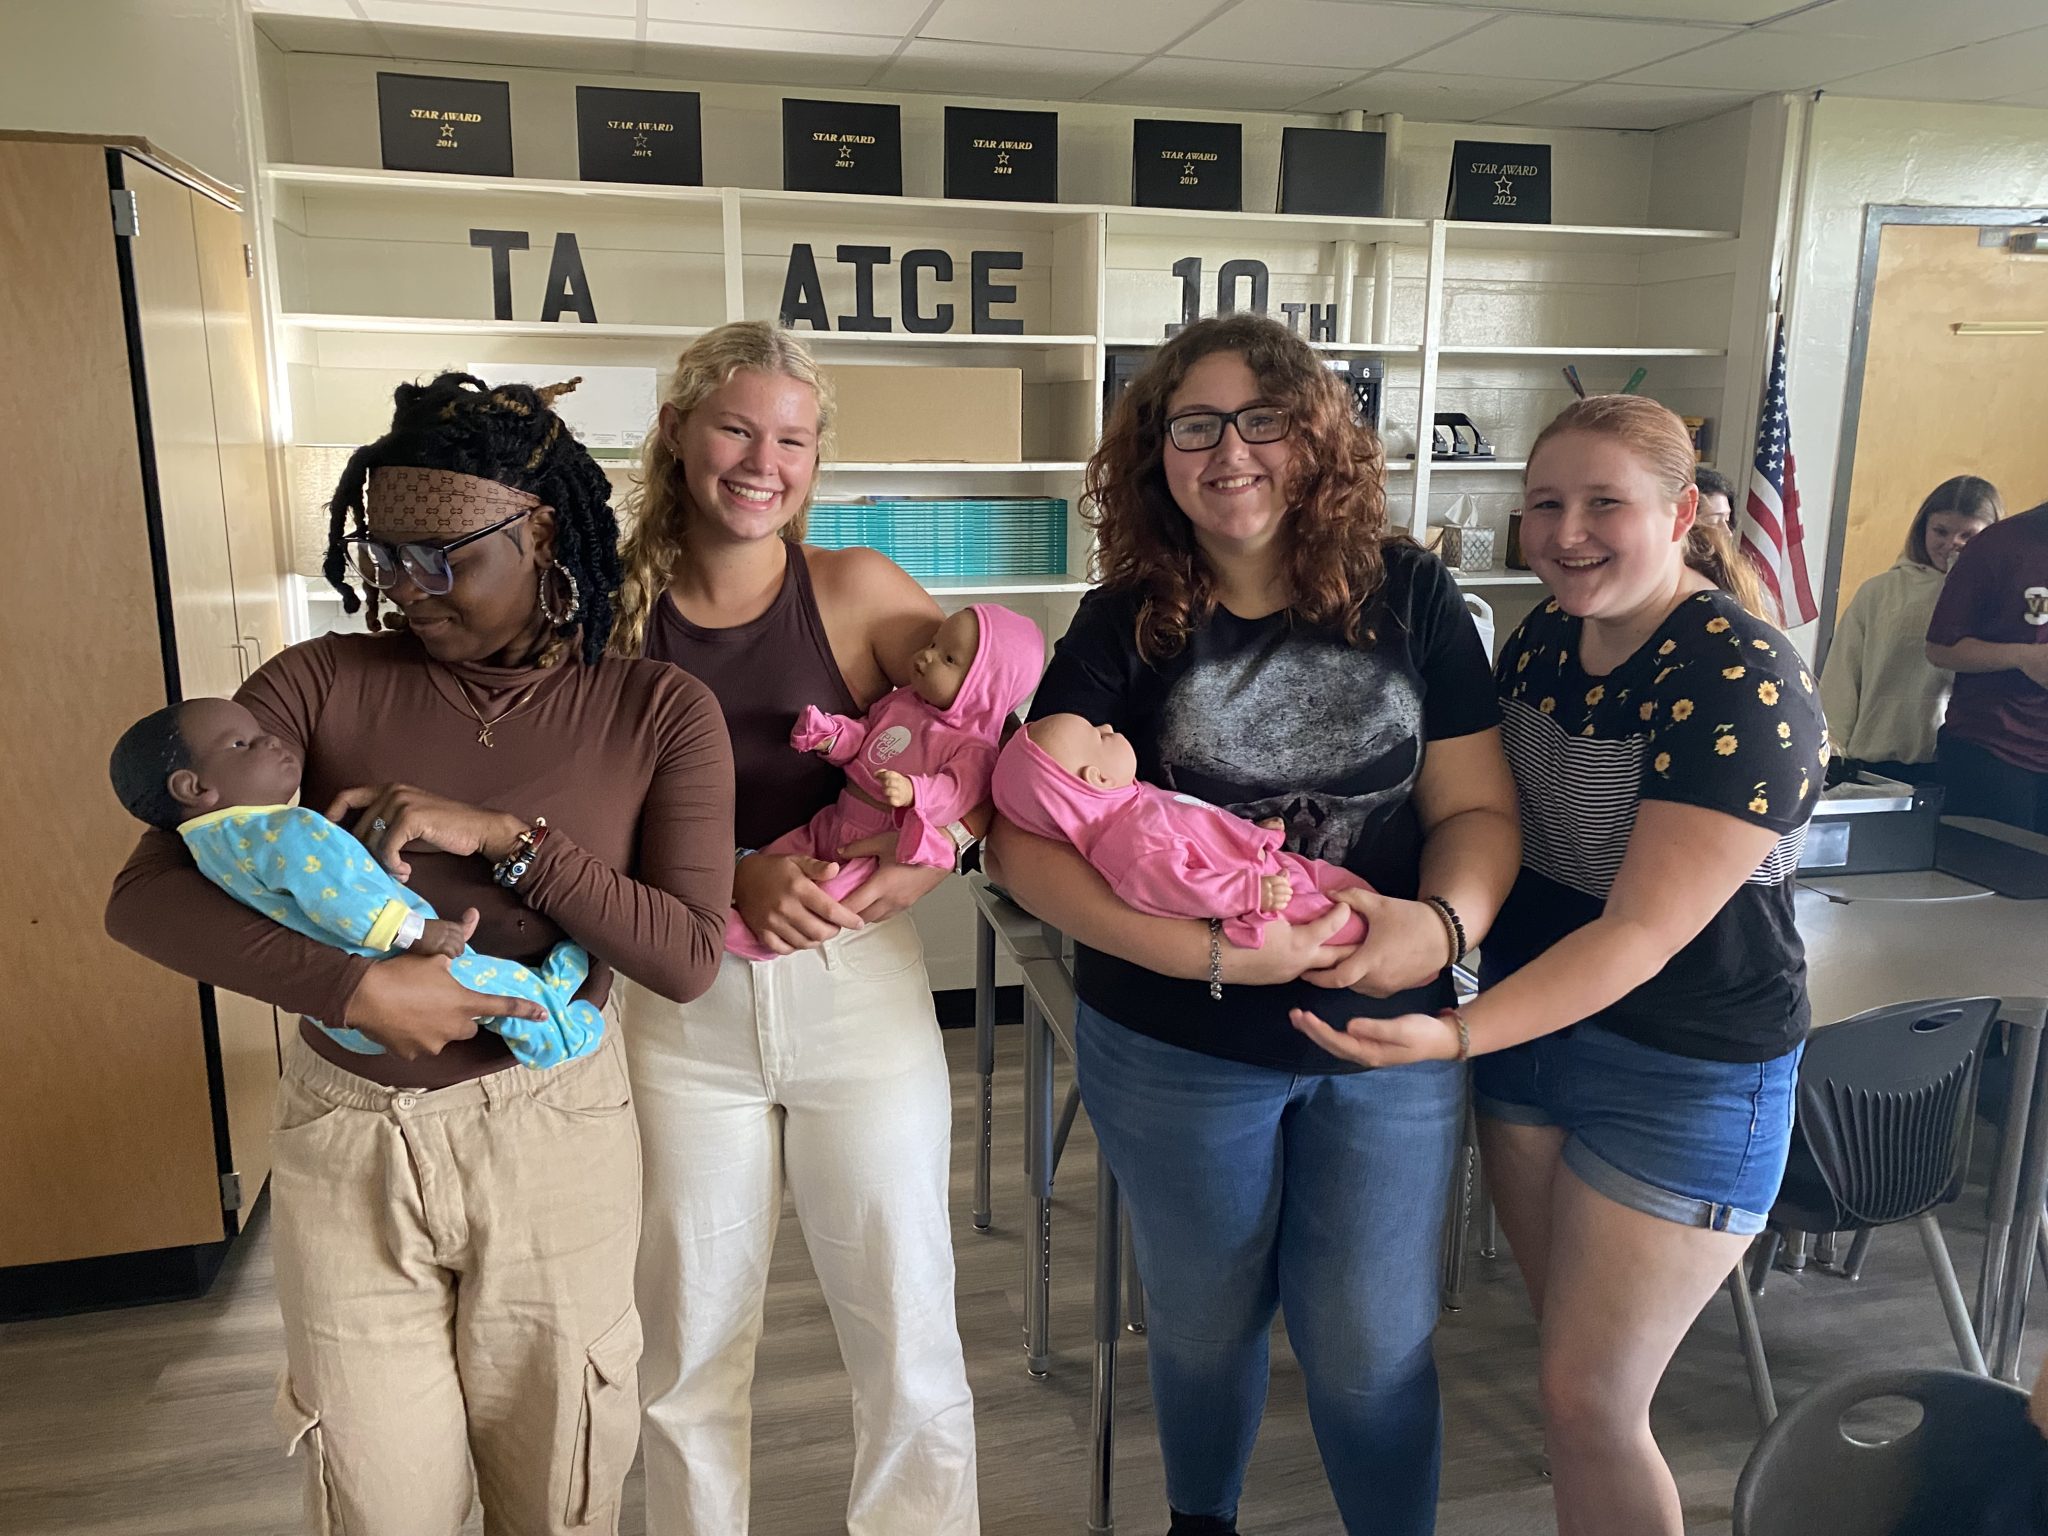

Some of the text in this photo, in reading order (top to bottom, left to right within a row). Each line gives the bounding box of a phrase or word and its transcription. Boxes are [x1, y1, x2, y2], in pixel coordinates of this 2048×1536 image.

[410, 108, 482, 123] STAR AWARD
[607, 120, 674, 132] STAR AWARD
[813, 132, 876, 145] STAR AWARD
[972, 139, 1033, 151] STAR AWARD
[1161, 150, 1218, 161] STAR AWARD
[835, 159, 855, 168] 2017
[1471, 162, 1538, 176] STAR AWARD
[994, 166, 1013, 175] 2018
[1180, 176, 1199, 185] 2019
[1492, 195, 1517, 206] 2022
[470, 228, 598, 324] TA
[779, 243, 1023, 336] AICE
[1363, 367, 1371, 378] 6
